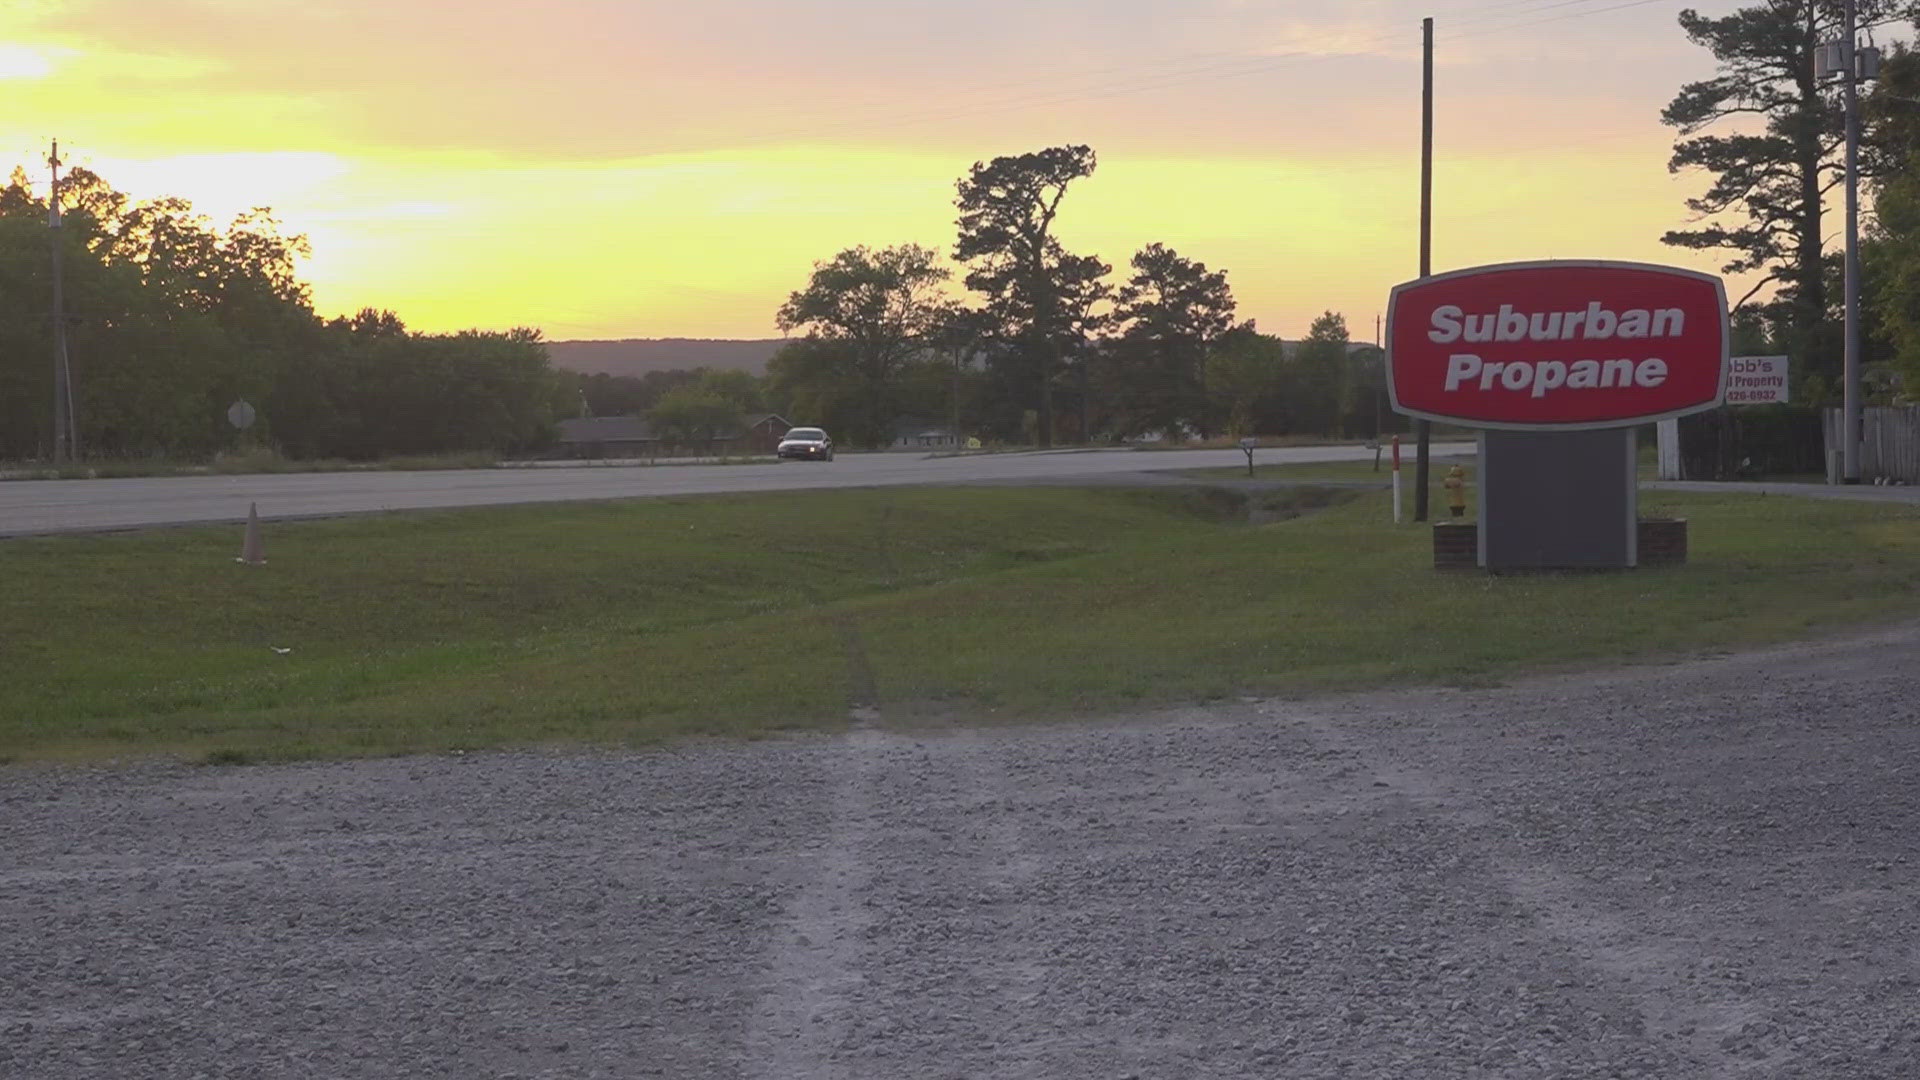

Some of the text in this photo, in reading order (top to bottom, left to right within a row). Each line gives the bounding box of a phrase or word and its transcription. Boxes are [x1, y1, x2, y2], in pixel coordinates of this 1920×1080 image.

[1428, 302, 1685, 344] Suburban
[1444, 354, 1668, 398] Propane
[1735, 375, 1783, 388] Property
